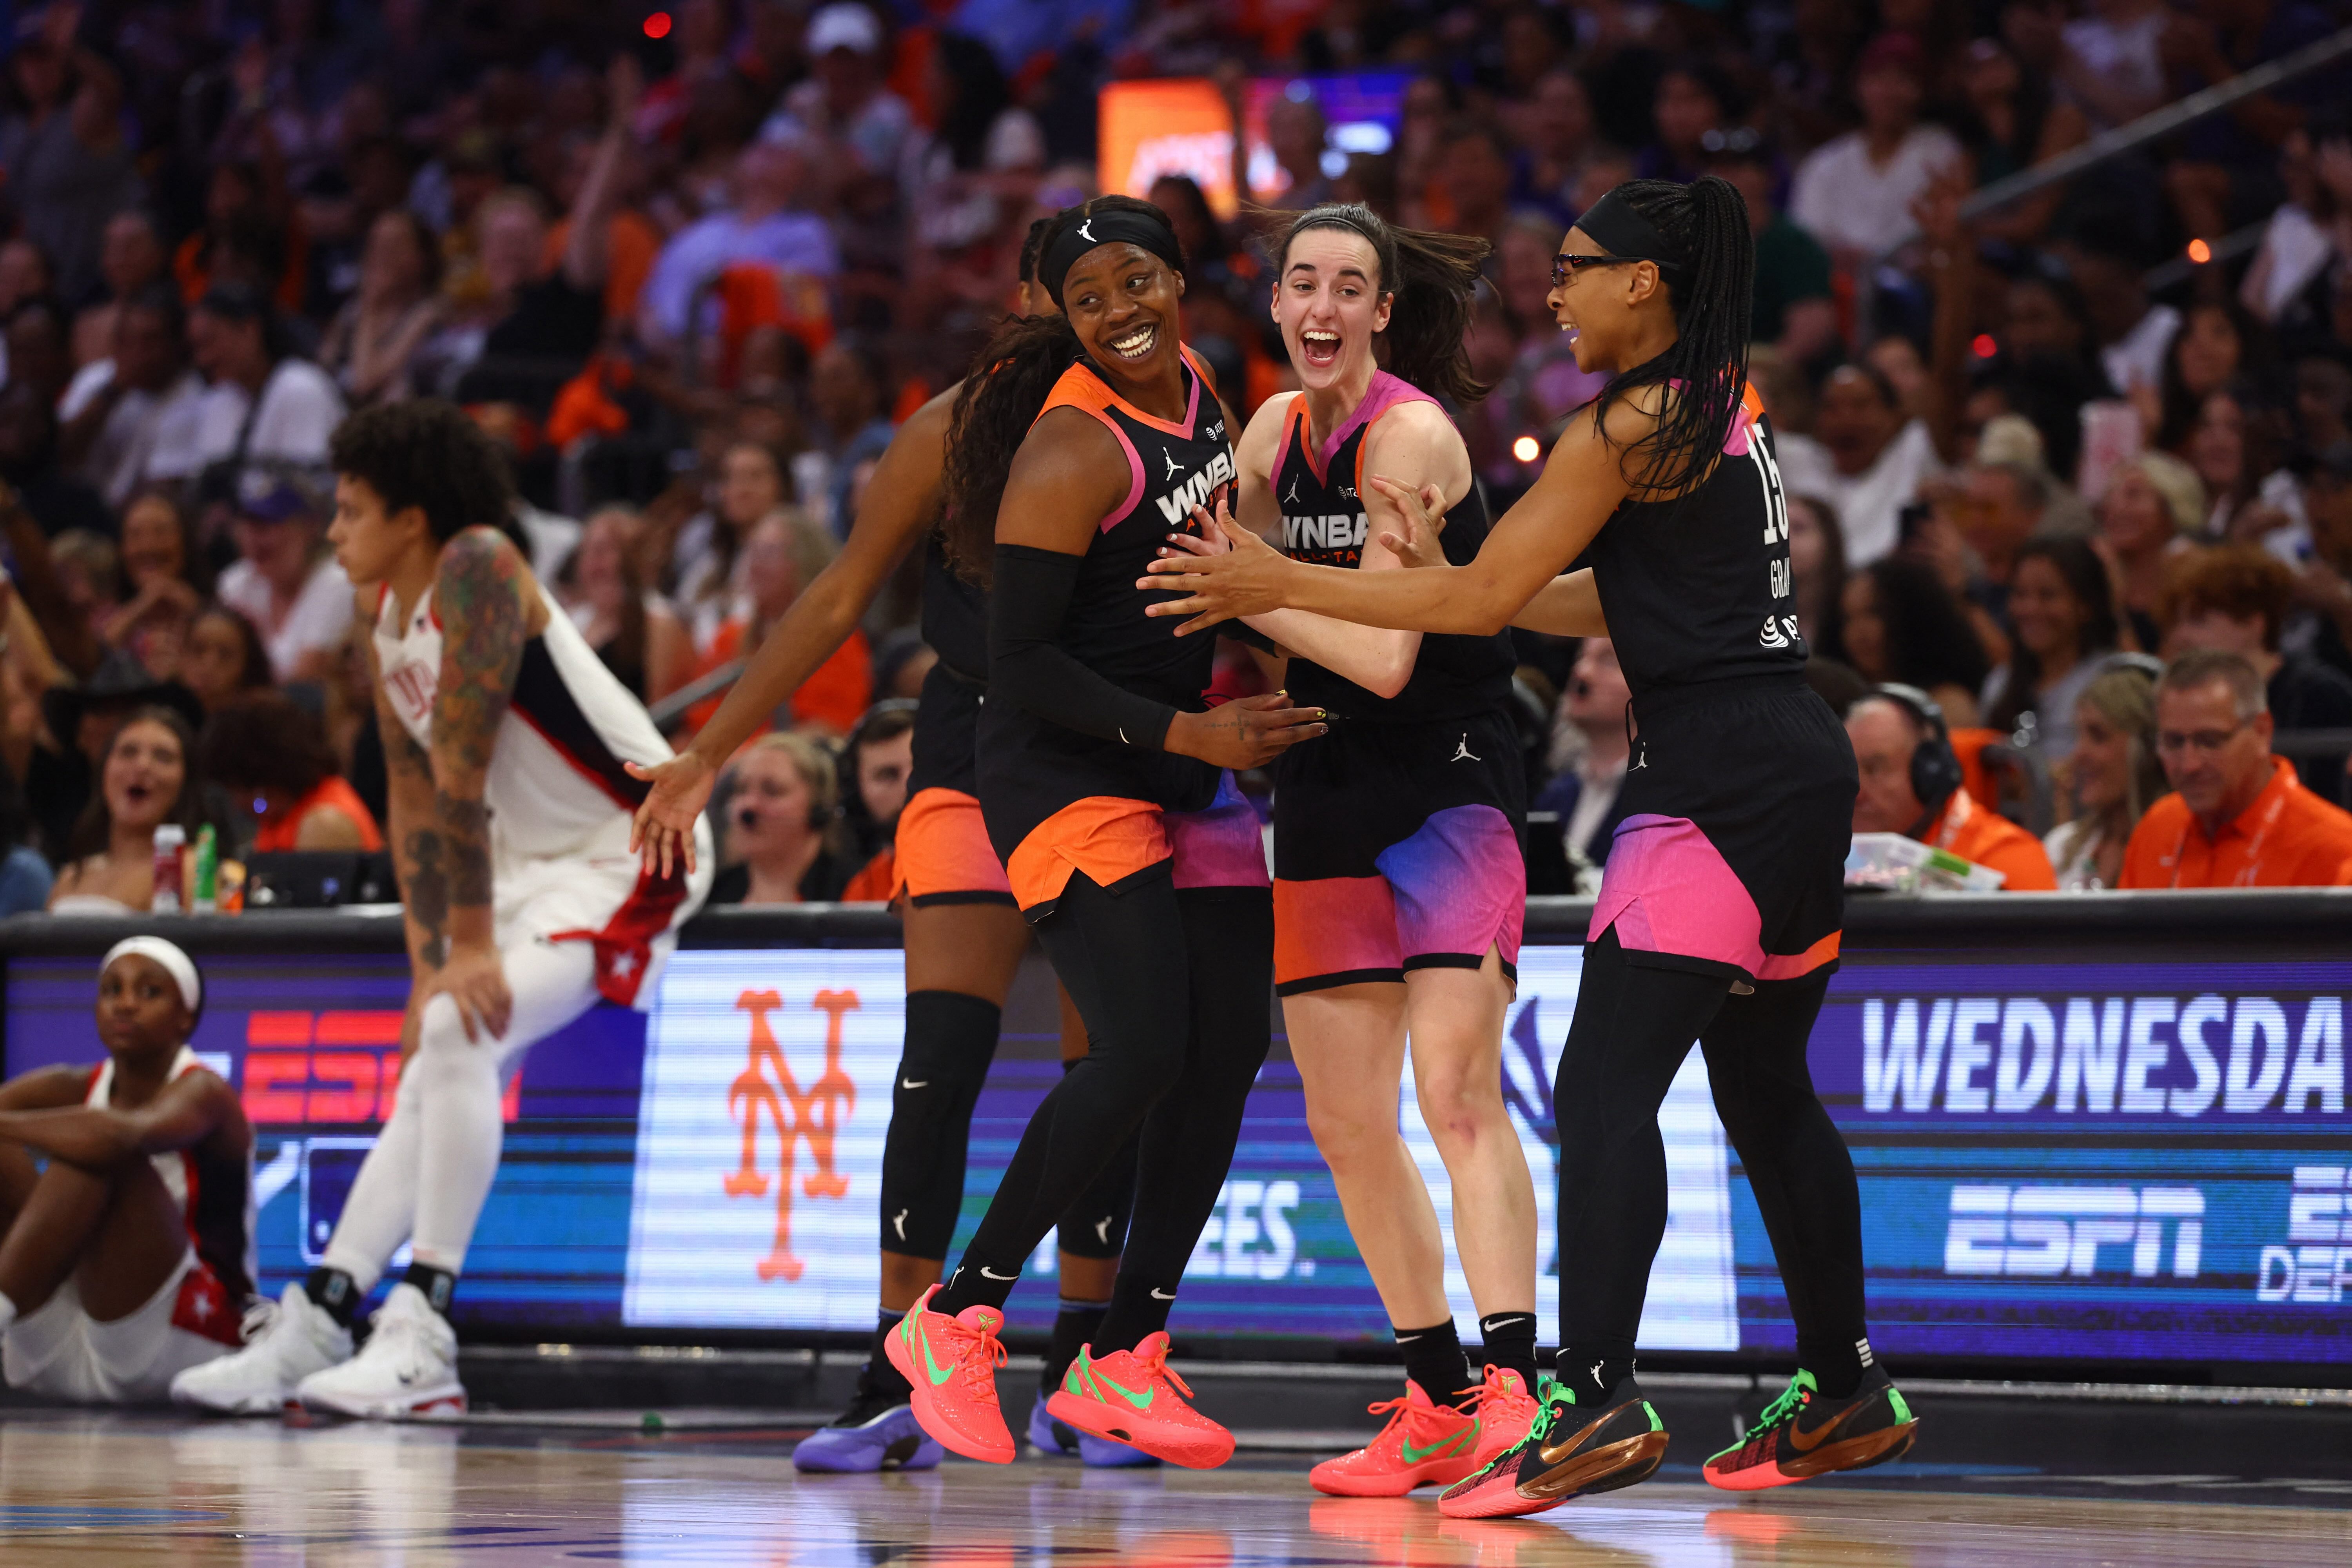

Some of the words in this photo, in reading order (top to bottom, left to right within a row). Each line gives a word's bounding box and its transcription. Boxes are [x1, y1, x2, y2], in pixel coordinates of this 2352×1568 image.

[1743, 423, 1789, 545] 15
[1863, 995, 2344, 1116] WEDNESDA
[1944, 1185, 2205, 1278] ESPN
